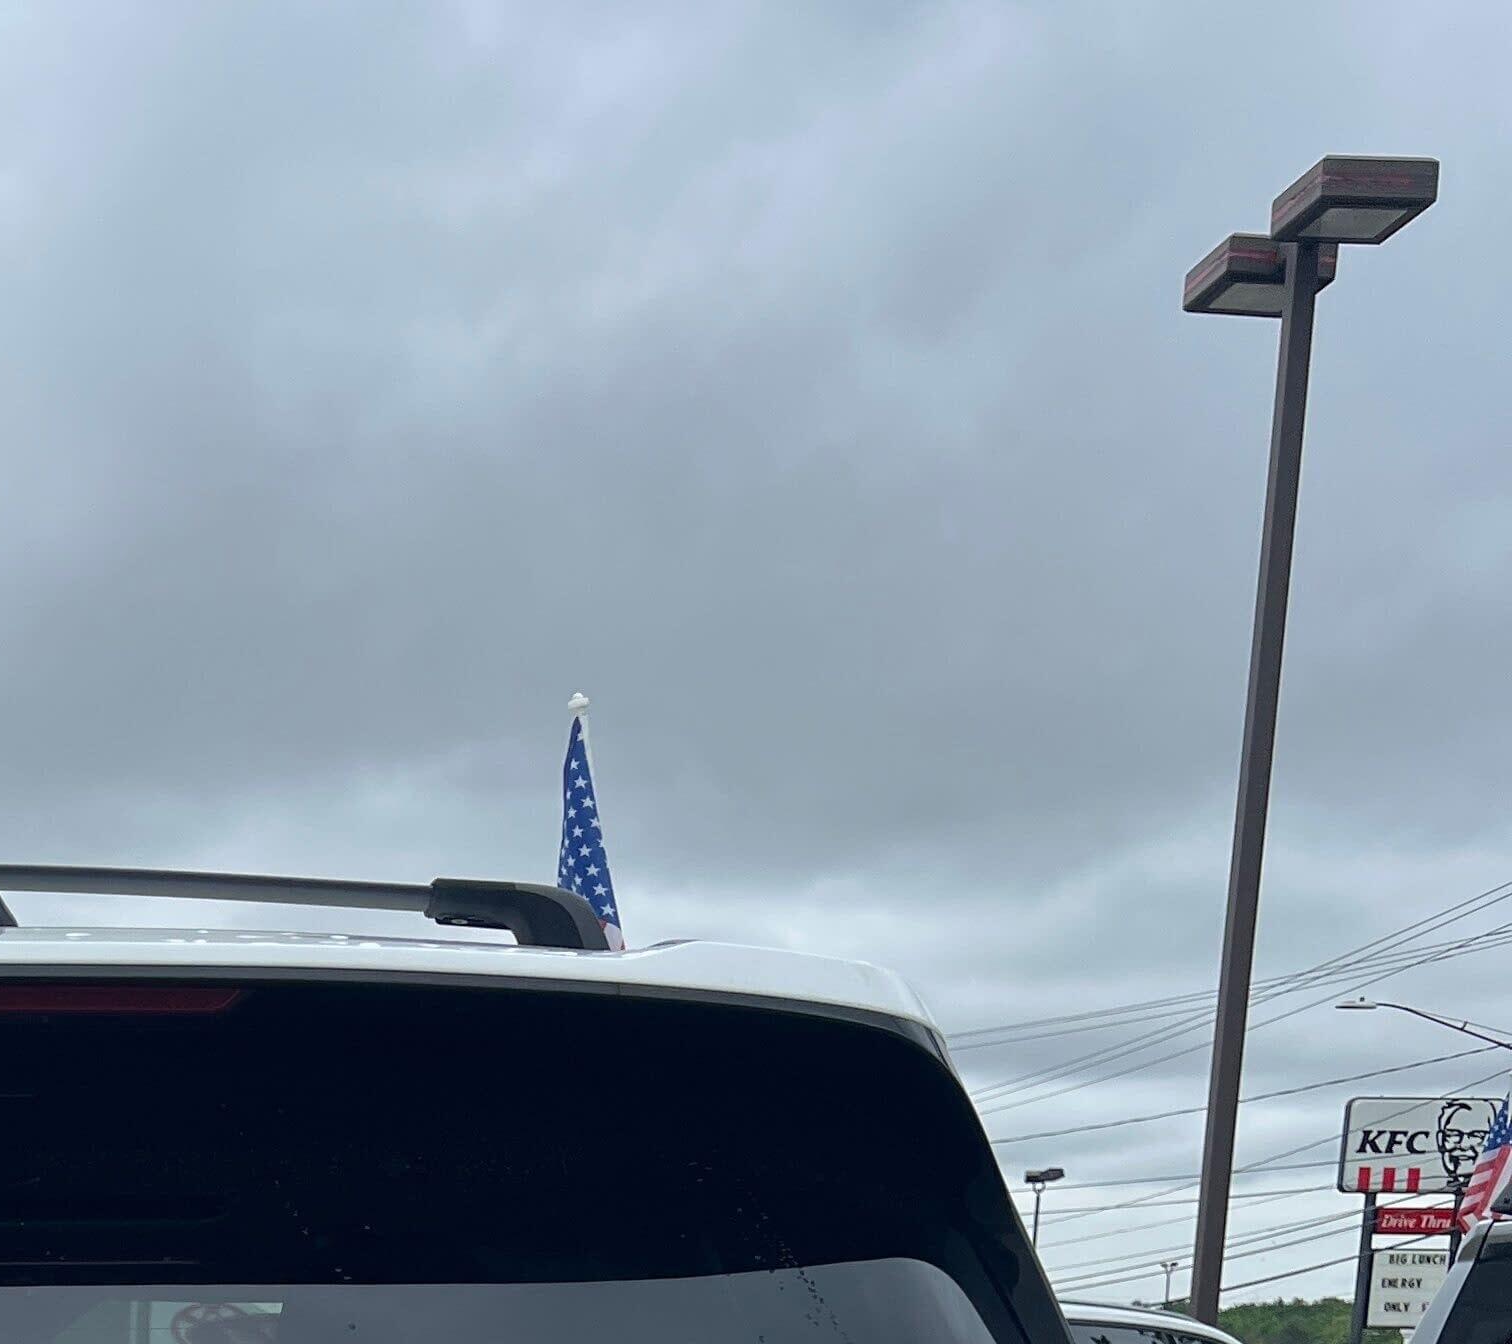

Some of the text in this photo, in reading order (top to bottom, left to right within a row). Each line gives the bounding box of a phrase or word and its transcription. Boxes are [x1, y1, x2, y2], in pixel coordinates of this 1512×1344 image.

[1356, 1130, 1430, 1154] KFC
[1381, 1214, 1417, 1229] Drive
[1389, 1253, 1446, 1266] BIG LUNCH
[1381, 1277, 1423, 1289] ENERGY
[1384, 1302, 1410, 1313] ONLY
